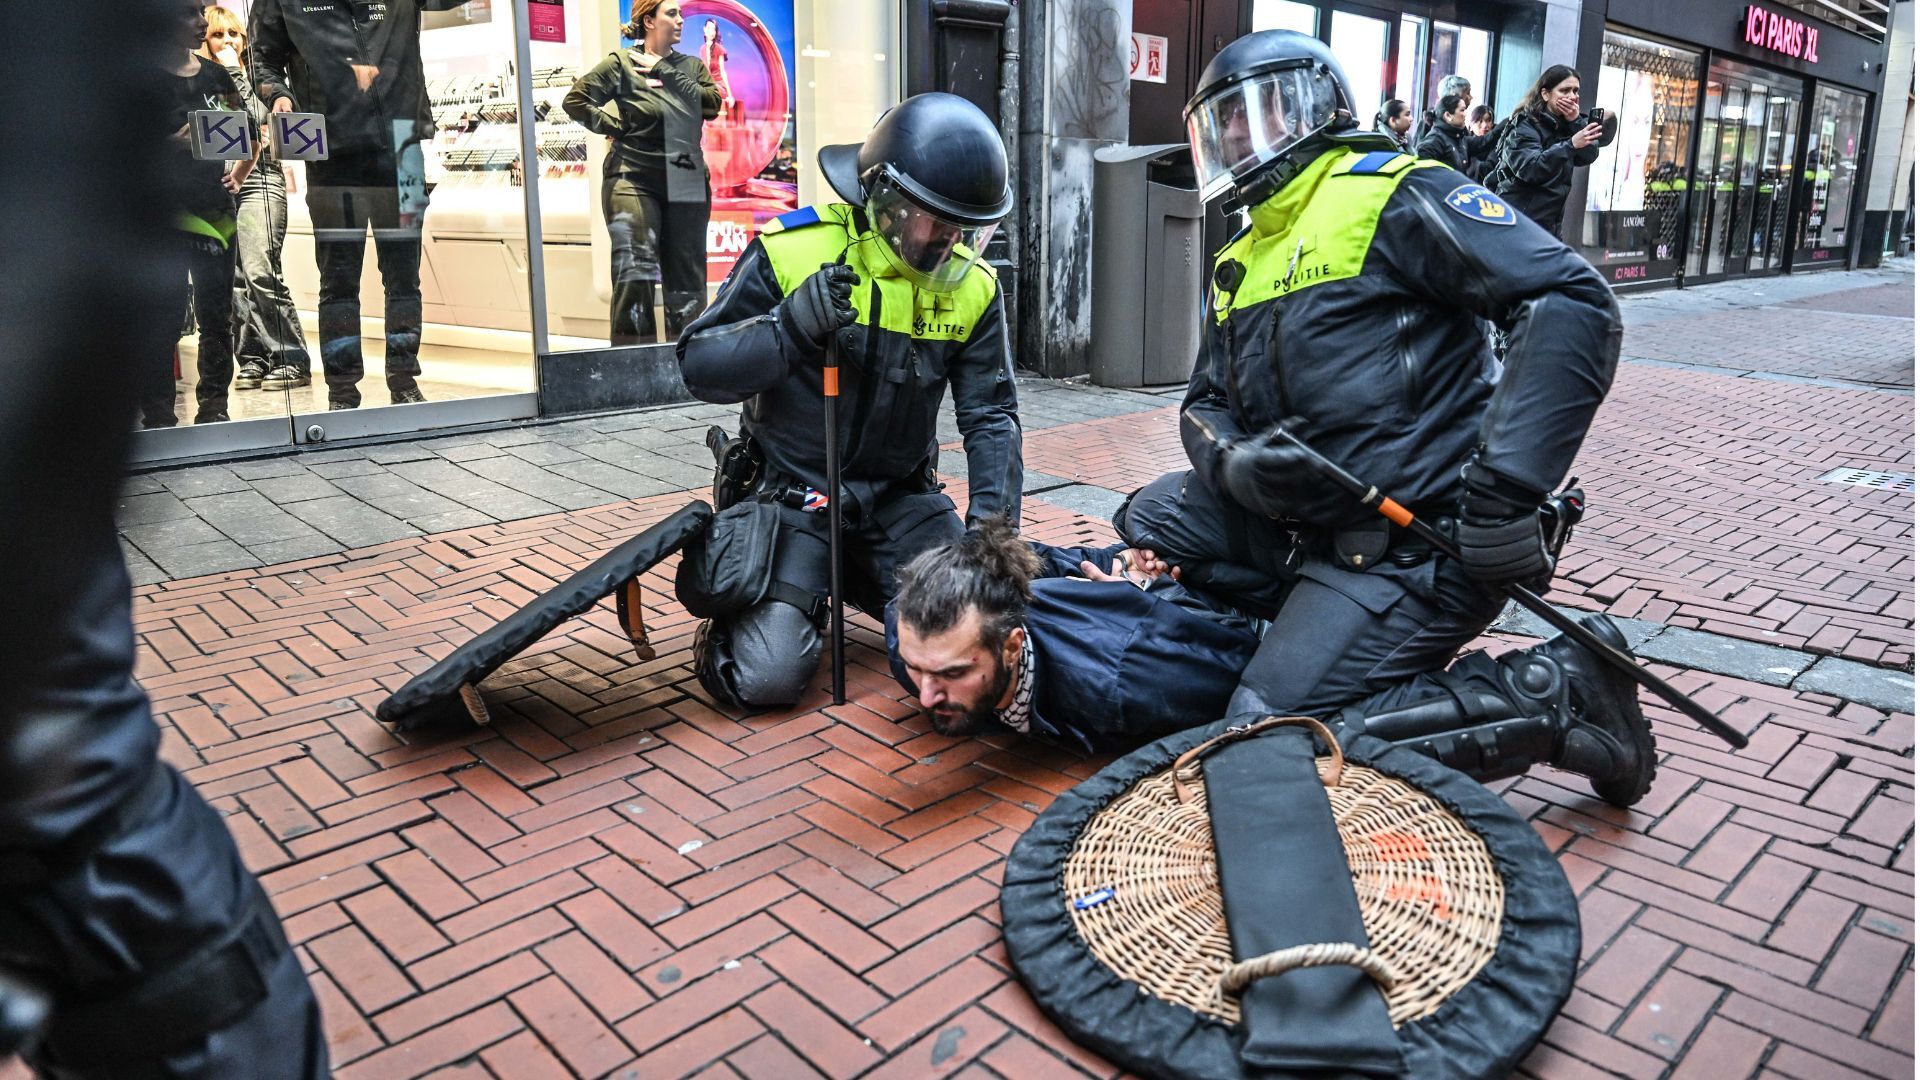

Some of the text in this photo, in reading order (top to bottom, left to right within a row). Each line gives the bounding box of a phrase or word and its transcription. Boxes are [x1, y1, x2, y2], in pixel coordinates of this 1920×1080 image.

[1745, 5, 1819, 63] ICI PARIS XL
